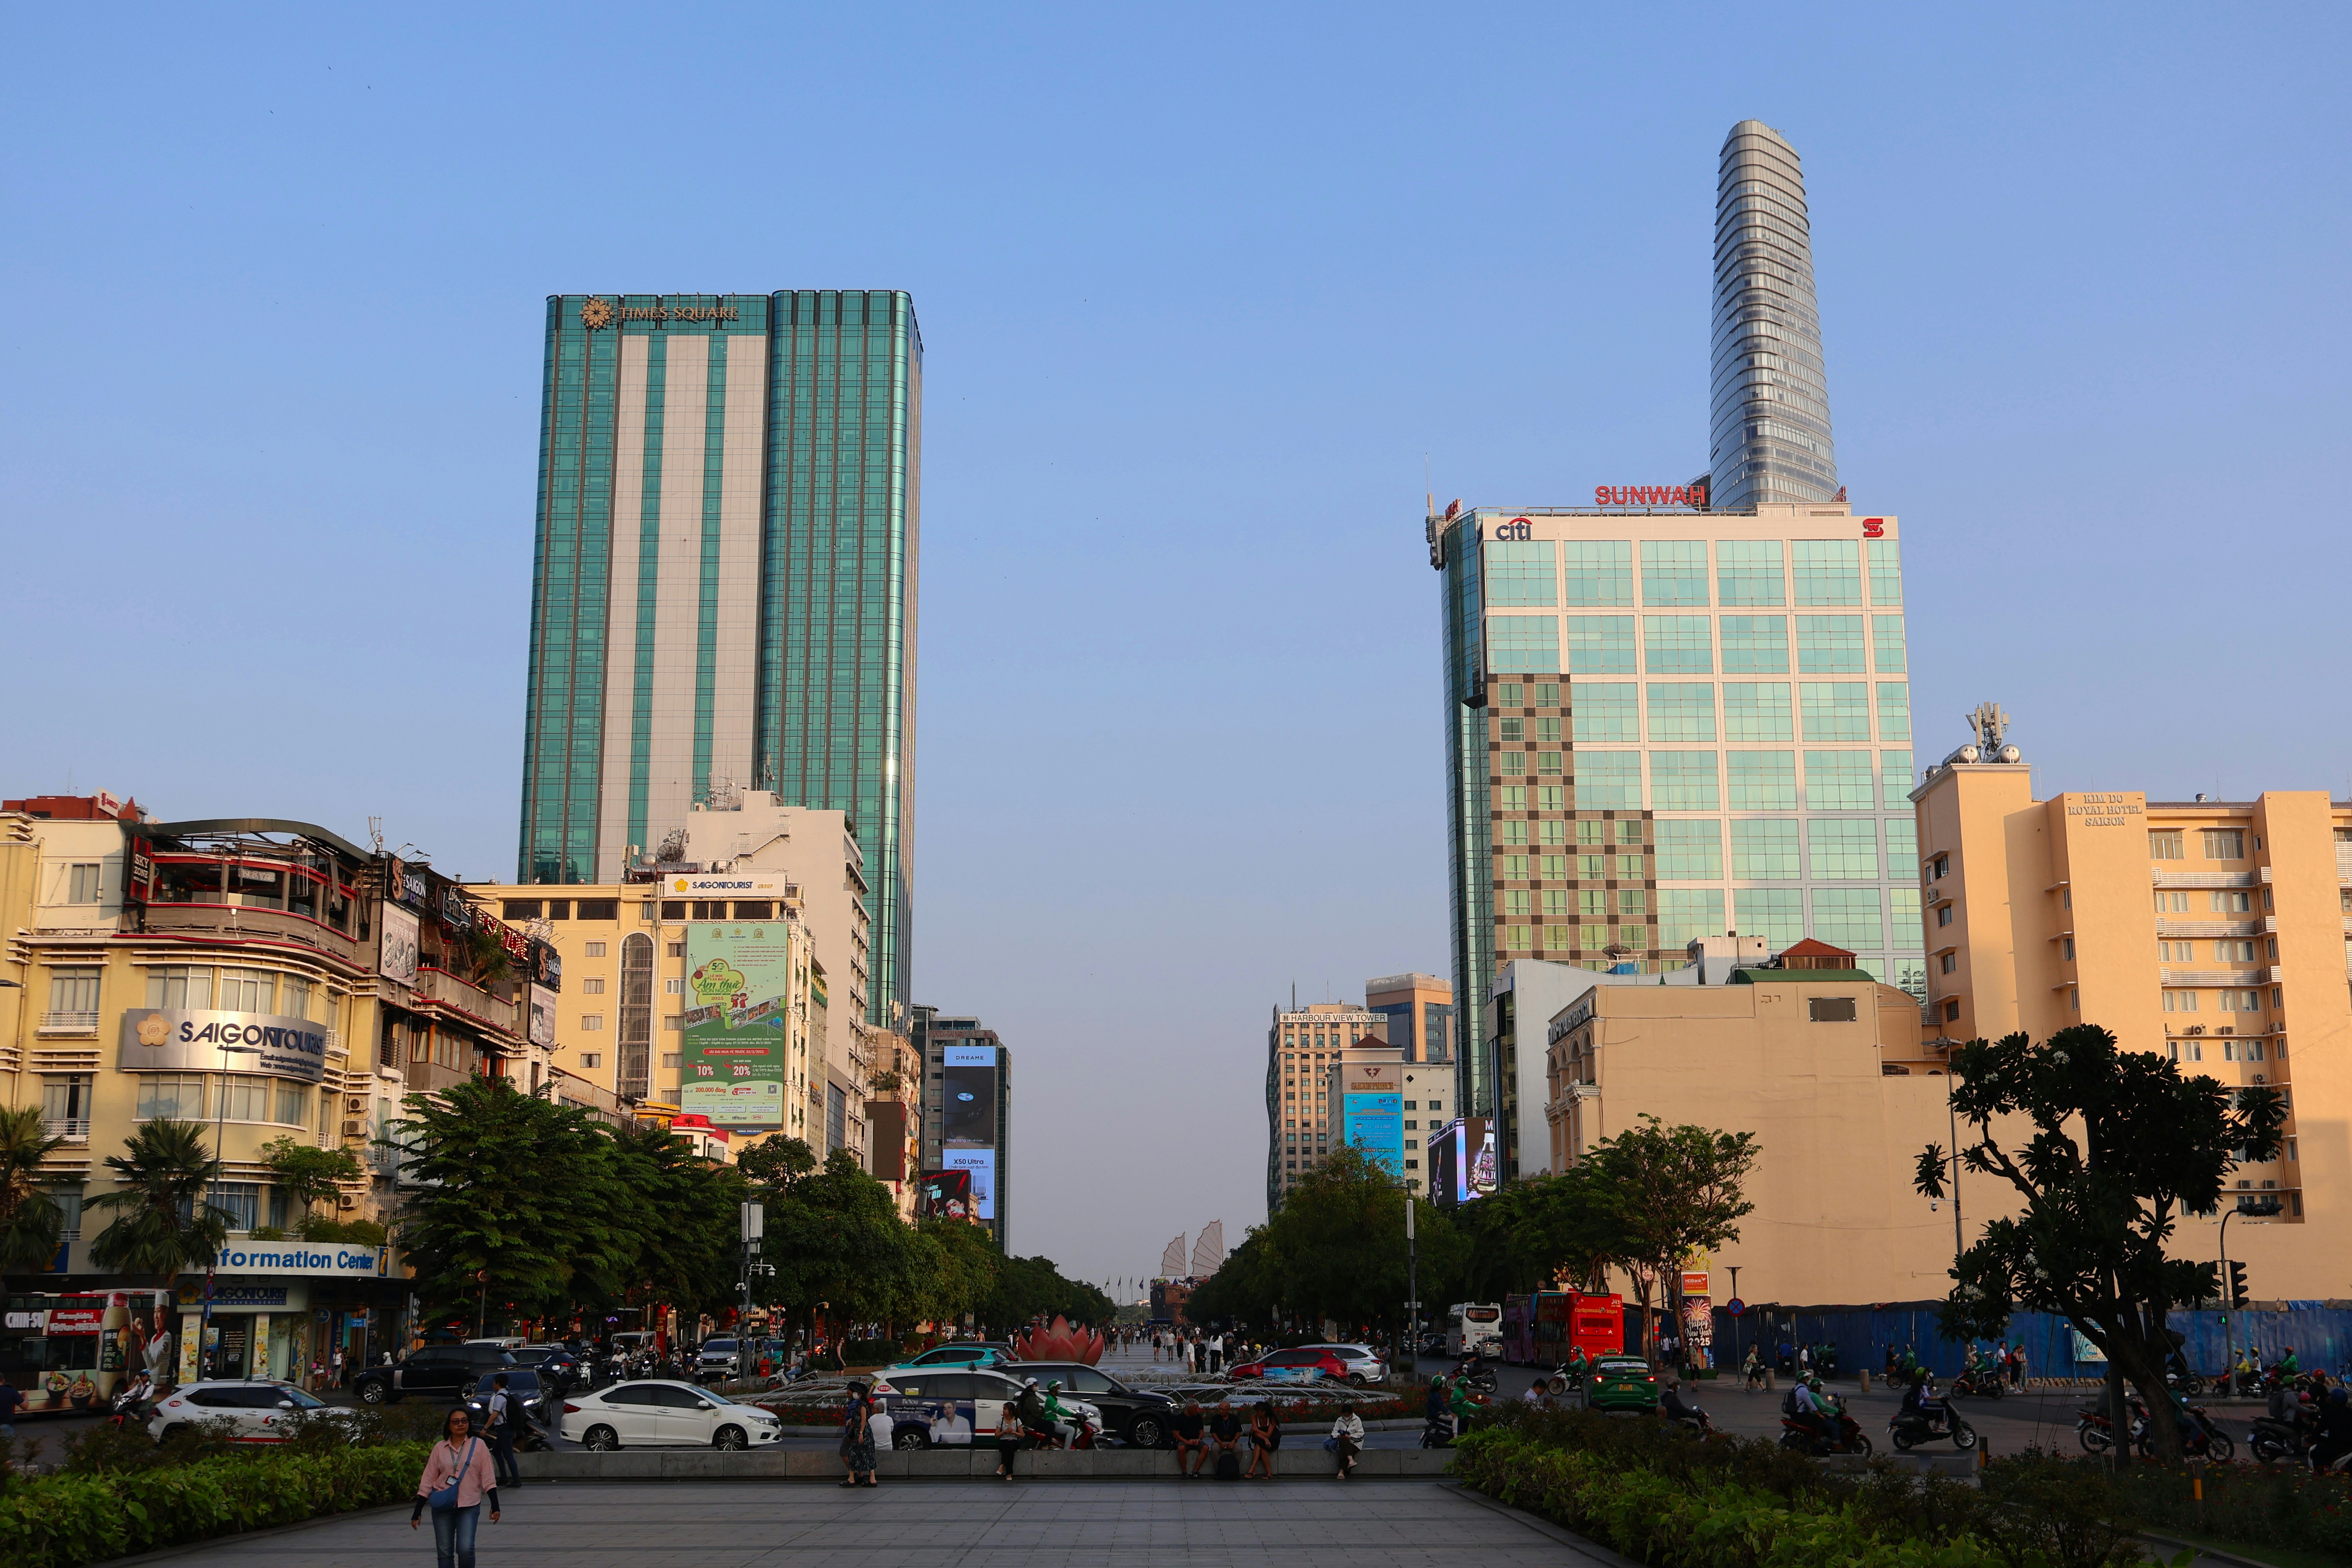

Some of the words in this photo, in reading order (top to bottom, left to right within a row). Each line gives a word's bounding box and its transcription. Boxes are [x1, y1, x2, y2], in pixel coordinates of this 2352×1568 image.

[621, 307, 668, 318] TIMES
[673, 307, 739, 320] SQUARE
[1595, 486, 1706, 505] SUNWAH
[1496, 518, 1532, 540] citi
[2084, 795, 2106, 803] KIM
[2109, 794, 2123, 803] DO
[2069, 806, 2104, 815] ROYAL
[2107, 805, 2143, 815] HOTEL
[2085, 817, 2125, 826] SAIGON
[135, 854, 149, 869] SKY
[134, 866, 149, 878] ZONE
[405, 875, 426, 898] SAIGON
[180, 1021, 325, 1056] SAIGONTOURIST
[697, 1065, 714, 1076] 10%
[733, 1065, 751, 1076] 20%
[205, 1248, 331, 1268] formation
[338, 1250, 374, 1270] Center
[204, 1287, 289, 1299] AIGONTOURIST
[5, 1312, 45, 1328] CHIN-SU
[1687, 1318, 1709, 1330] Happy
[1685, 1328, 1698, 1338] New
[1699, 1327, 1712, 1338] Year
[1688, 1338, 1711, 1346] 2025
